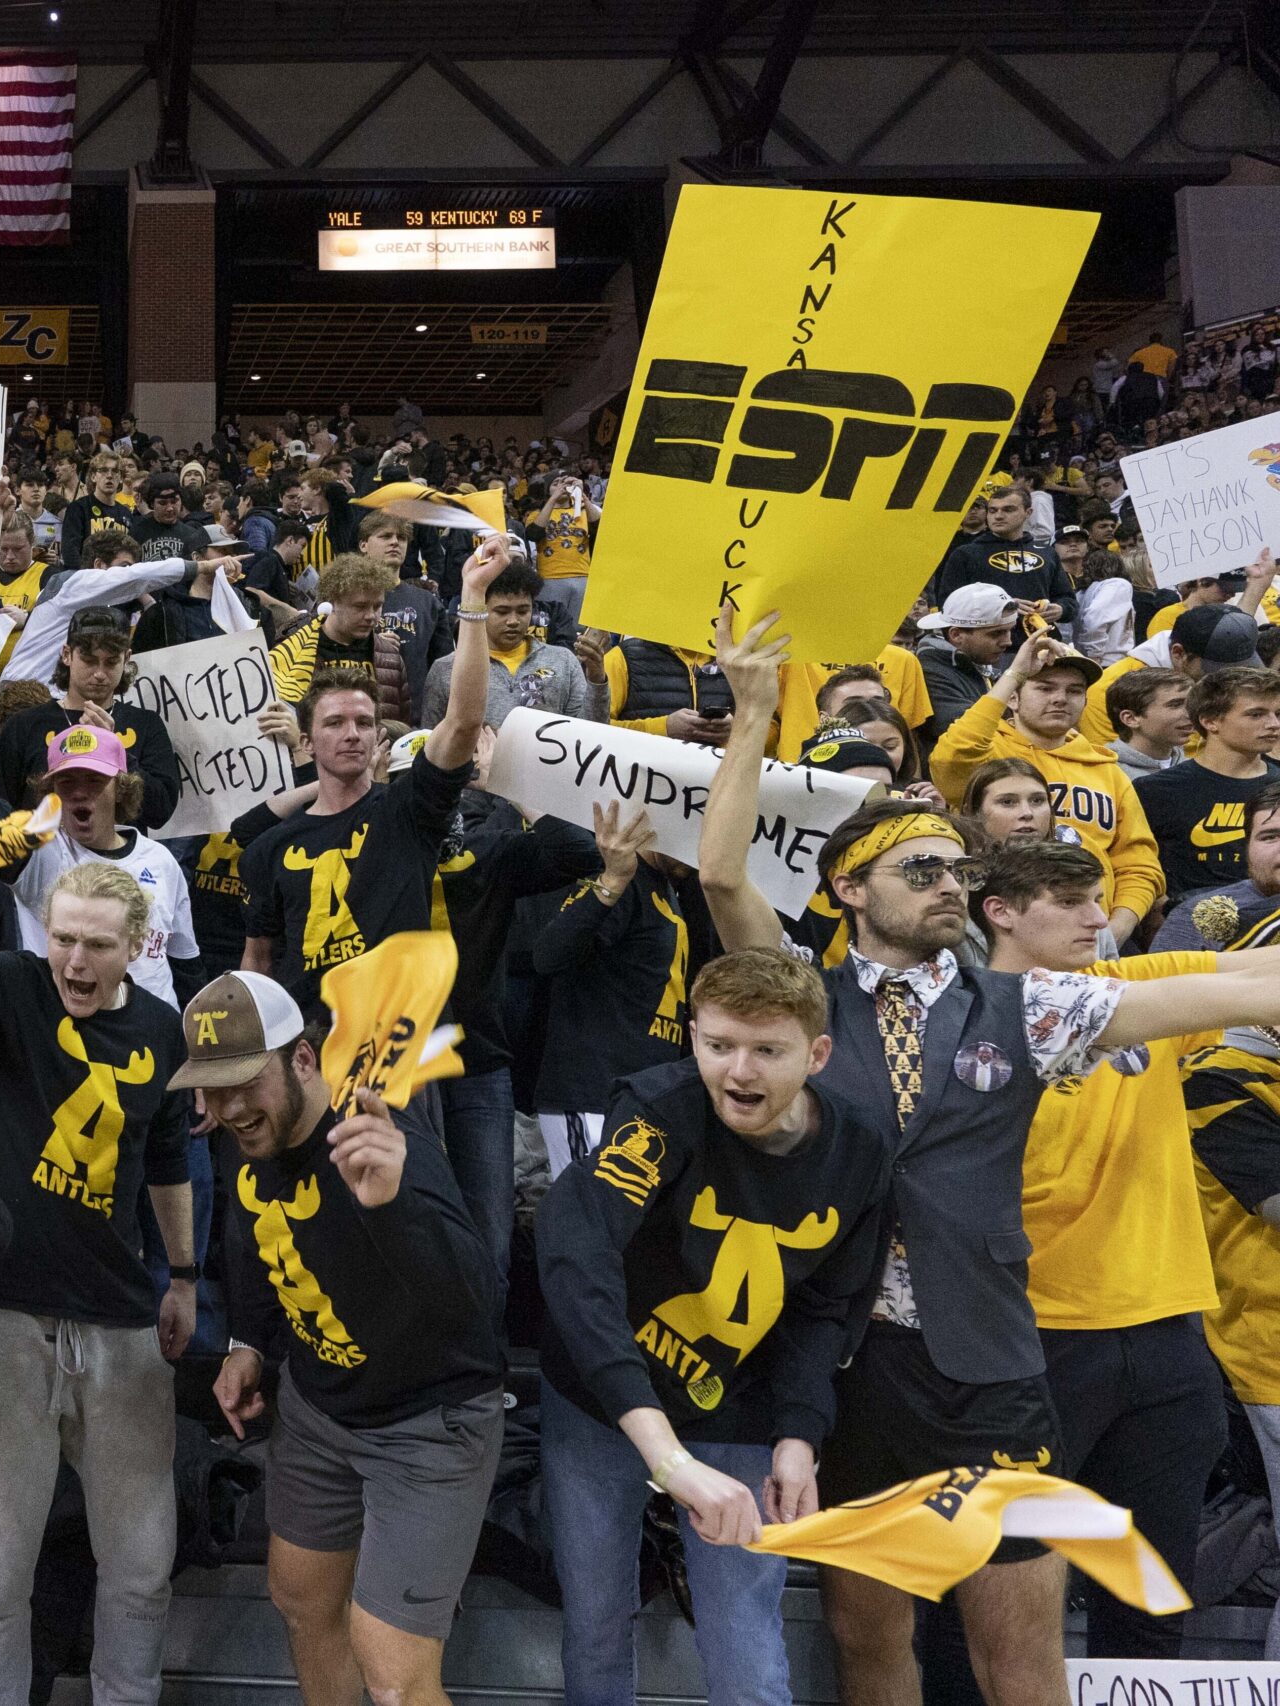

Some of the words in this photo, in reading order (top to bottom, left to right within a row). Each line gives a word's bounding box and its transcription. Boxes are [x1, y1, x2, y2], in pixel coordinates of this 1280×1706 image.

[328, 212, 363, 227] YALE
[406, 210, 424, 225] 59
[431, 210, 498, 225] KENTUCKY
[509, 209, 527, 224] 69
[532, 209, 544, 223] F
[374, 241, 423, 254] GREAT
[426, 240, 505, 254] SOUTHERN
[509, 239, 551, 253] BANK
[478, 328, 542, 341] 120-119
[624, 358, 1017, 512] ESPN
[1133, 441, 1212, 494] IT'S
[1145, 475, 1256, 535] JAYHAWK
[1153, 511, 1264, 574] SEASON
[535, 718, 832, 875] SYNDRME
